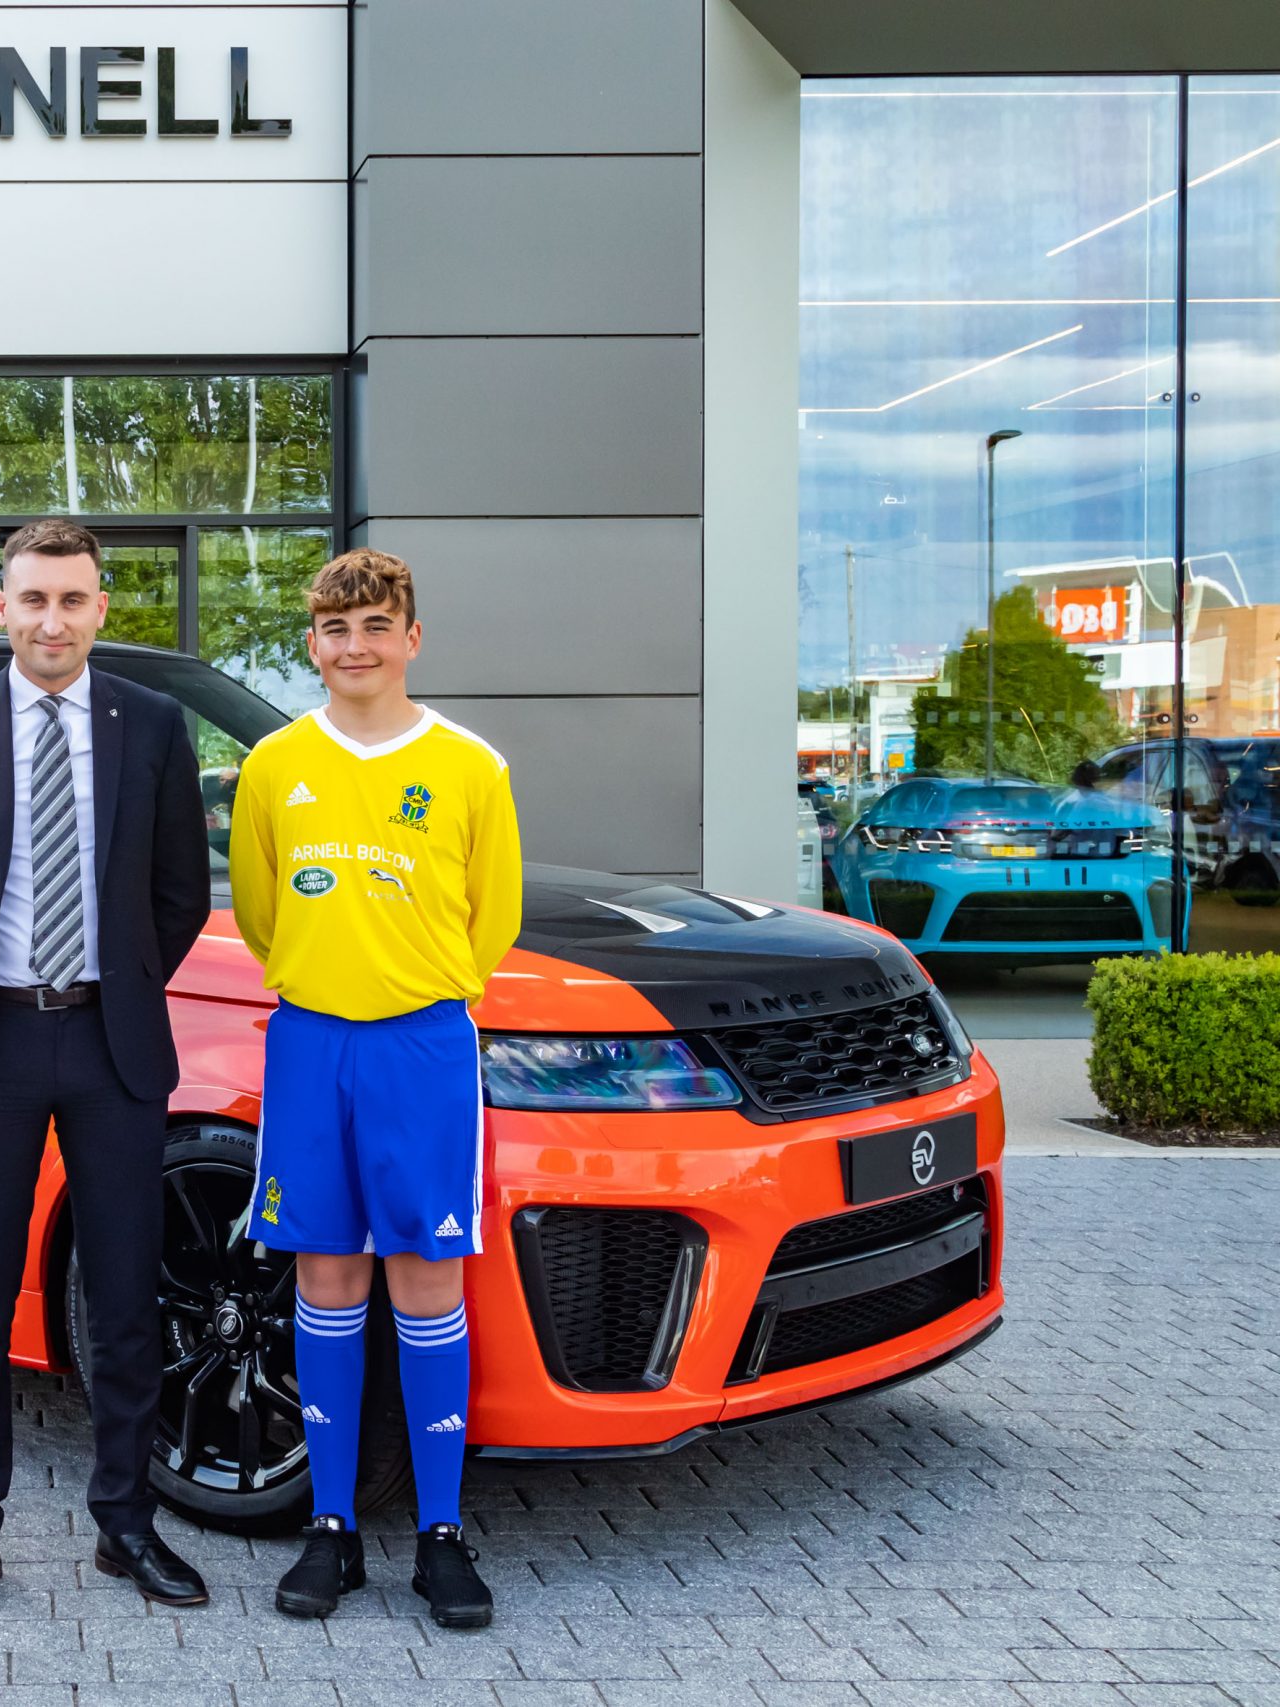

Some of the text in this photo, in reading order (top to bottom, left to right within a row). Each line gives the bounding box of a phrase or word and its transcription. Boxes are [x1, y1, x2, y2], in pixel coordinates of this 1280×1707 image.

[290, 842, 353, 862] ARNELL
[300, 873, 322, 882] LAND
[302, 881, 328, 890] ROVER
[708, 990, 830, 1017] RANGE
[435, 1226, 464, 1237] adidas
